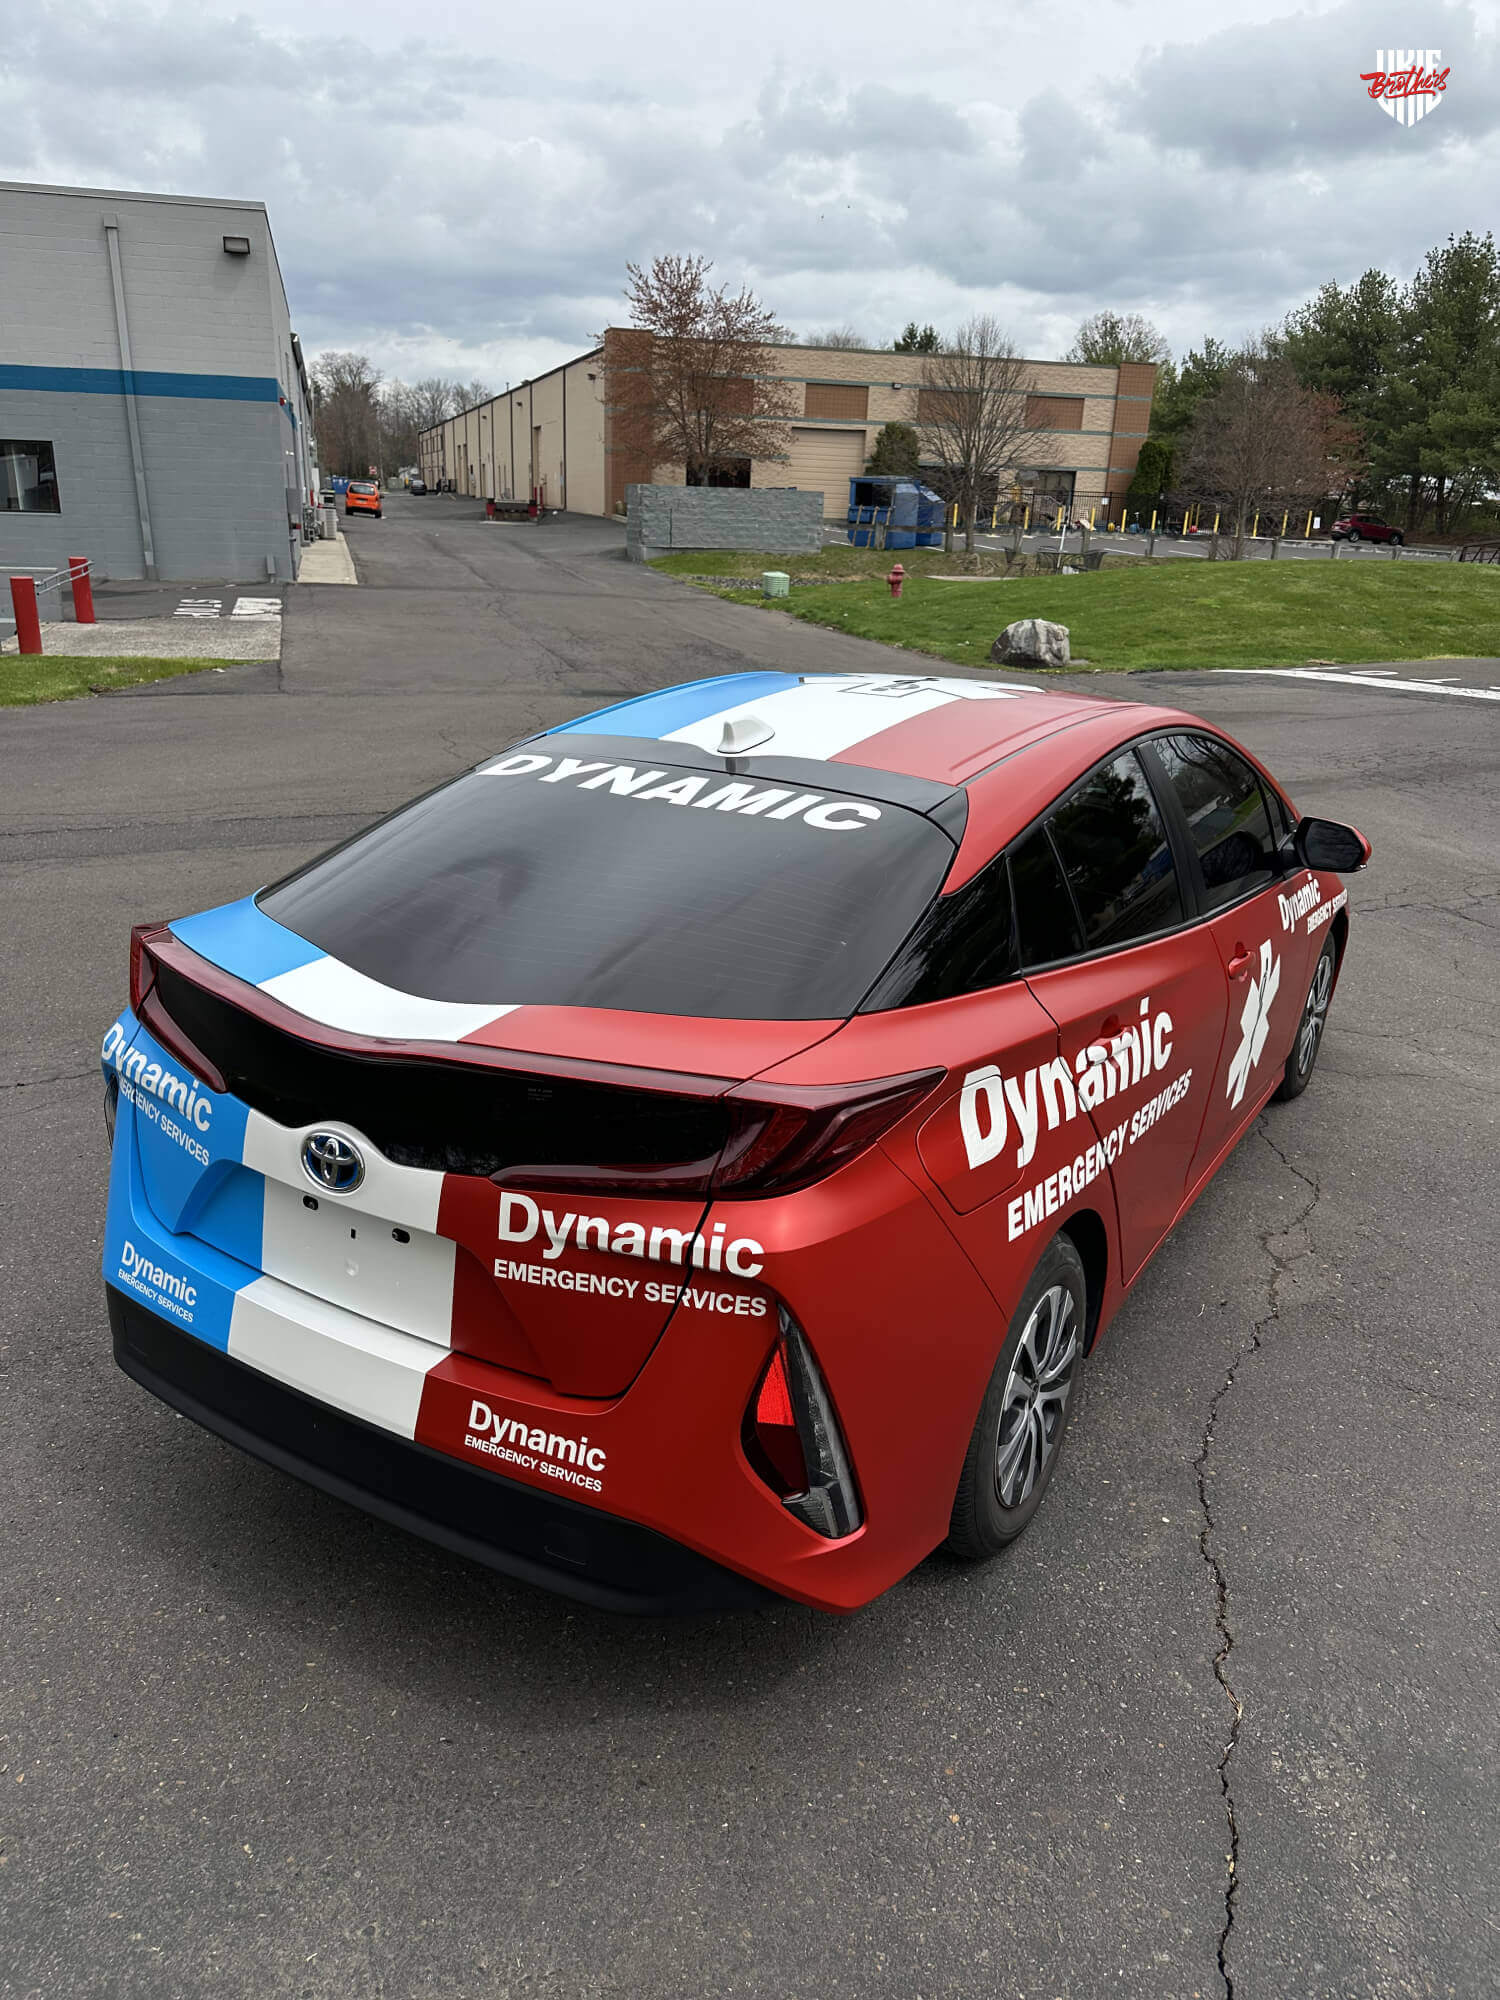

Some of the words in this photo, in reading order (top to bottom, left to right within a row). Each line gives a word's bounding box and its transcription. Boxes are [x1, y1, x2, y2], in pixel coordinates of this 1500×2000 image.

[475, 753, 882, 831] DYNAMIC
[1277, 872, 1321, 934] Dynamic
[102, 1022, 213, 1132] Dynamic
[959, 996, 1173, 1170] Dynamic
[117, 1073, 161, 1123] ERGENCY
[160, 1115, 210, 1166] SERVICES
[1007, 1119, 1129, 1243] EMERGENCY
[1129, 1068, 1193, 1145] SERVICES
[121, 1239, 197, 1306] Dynamic
[498, 1191, 765, 1279] Dynamic
[118, 1268, 158, 1300] EMERGENCY
[157, 1294, 194, 1323] SERVICES
[494, 1258, 639, 1299] EMERGENCY
[644, 1281, 767, 1317] SERVICES
[464, 1434, 538, 1470] EMERGENCY
[539, 1461, 603, 1493] SERVICES
[468, 1400, 607, 1472] Dynamic
